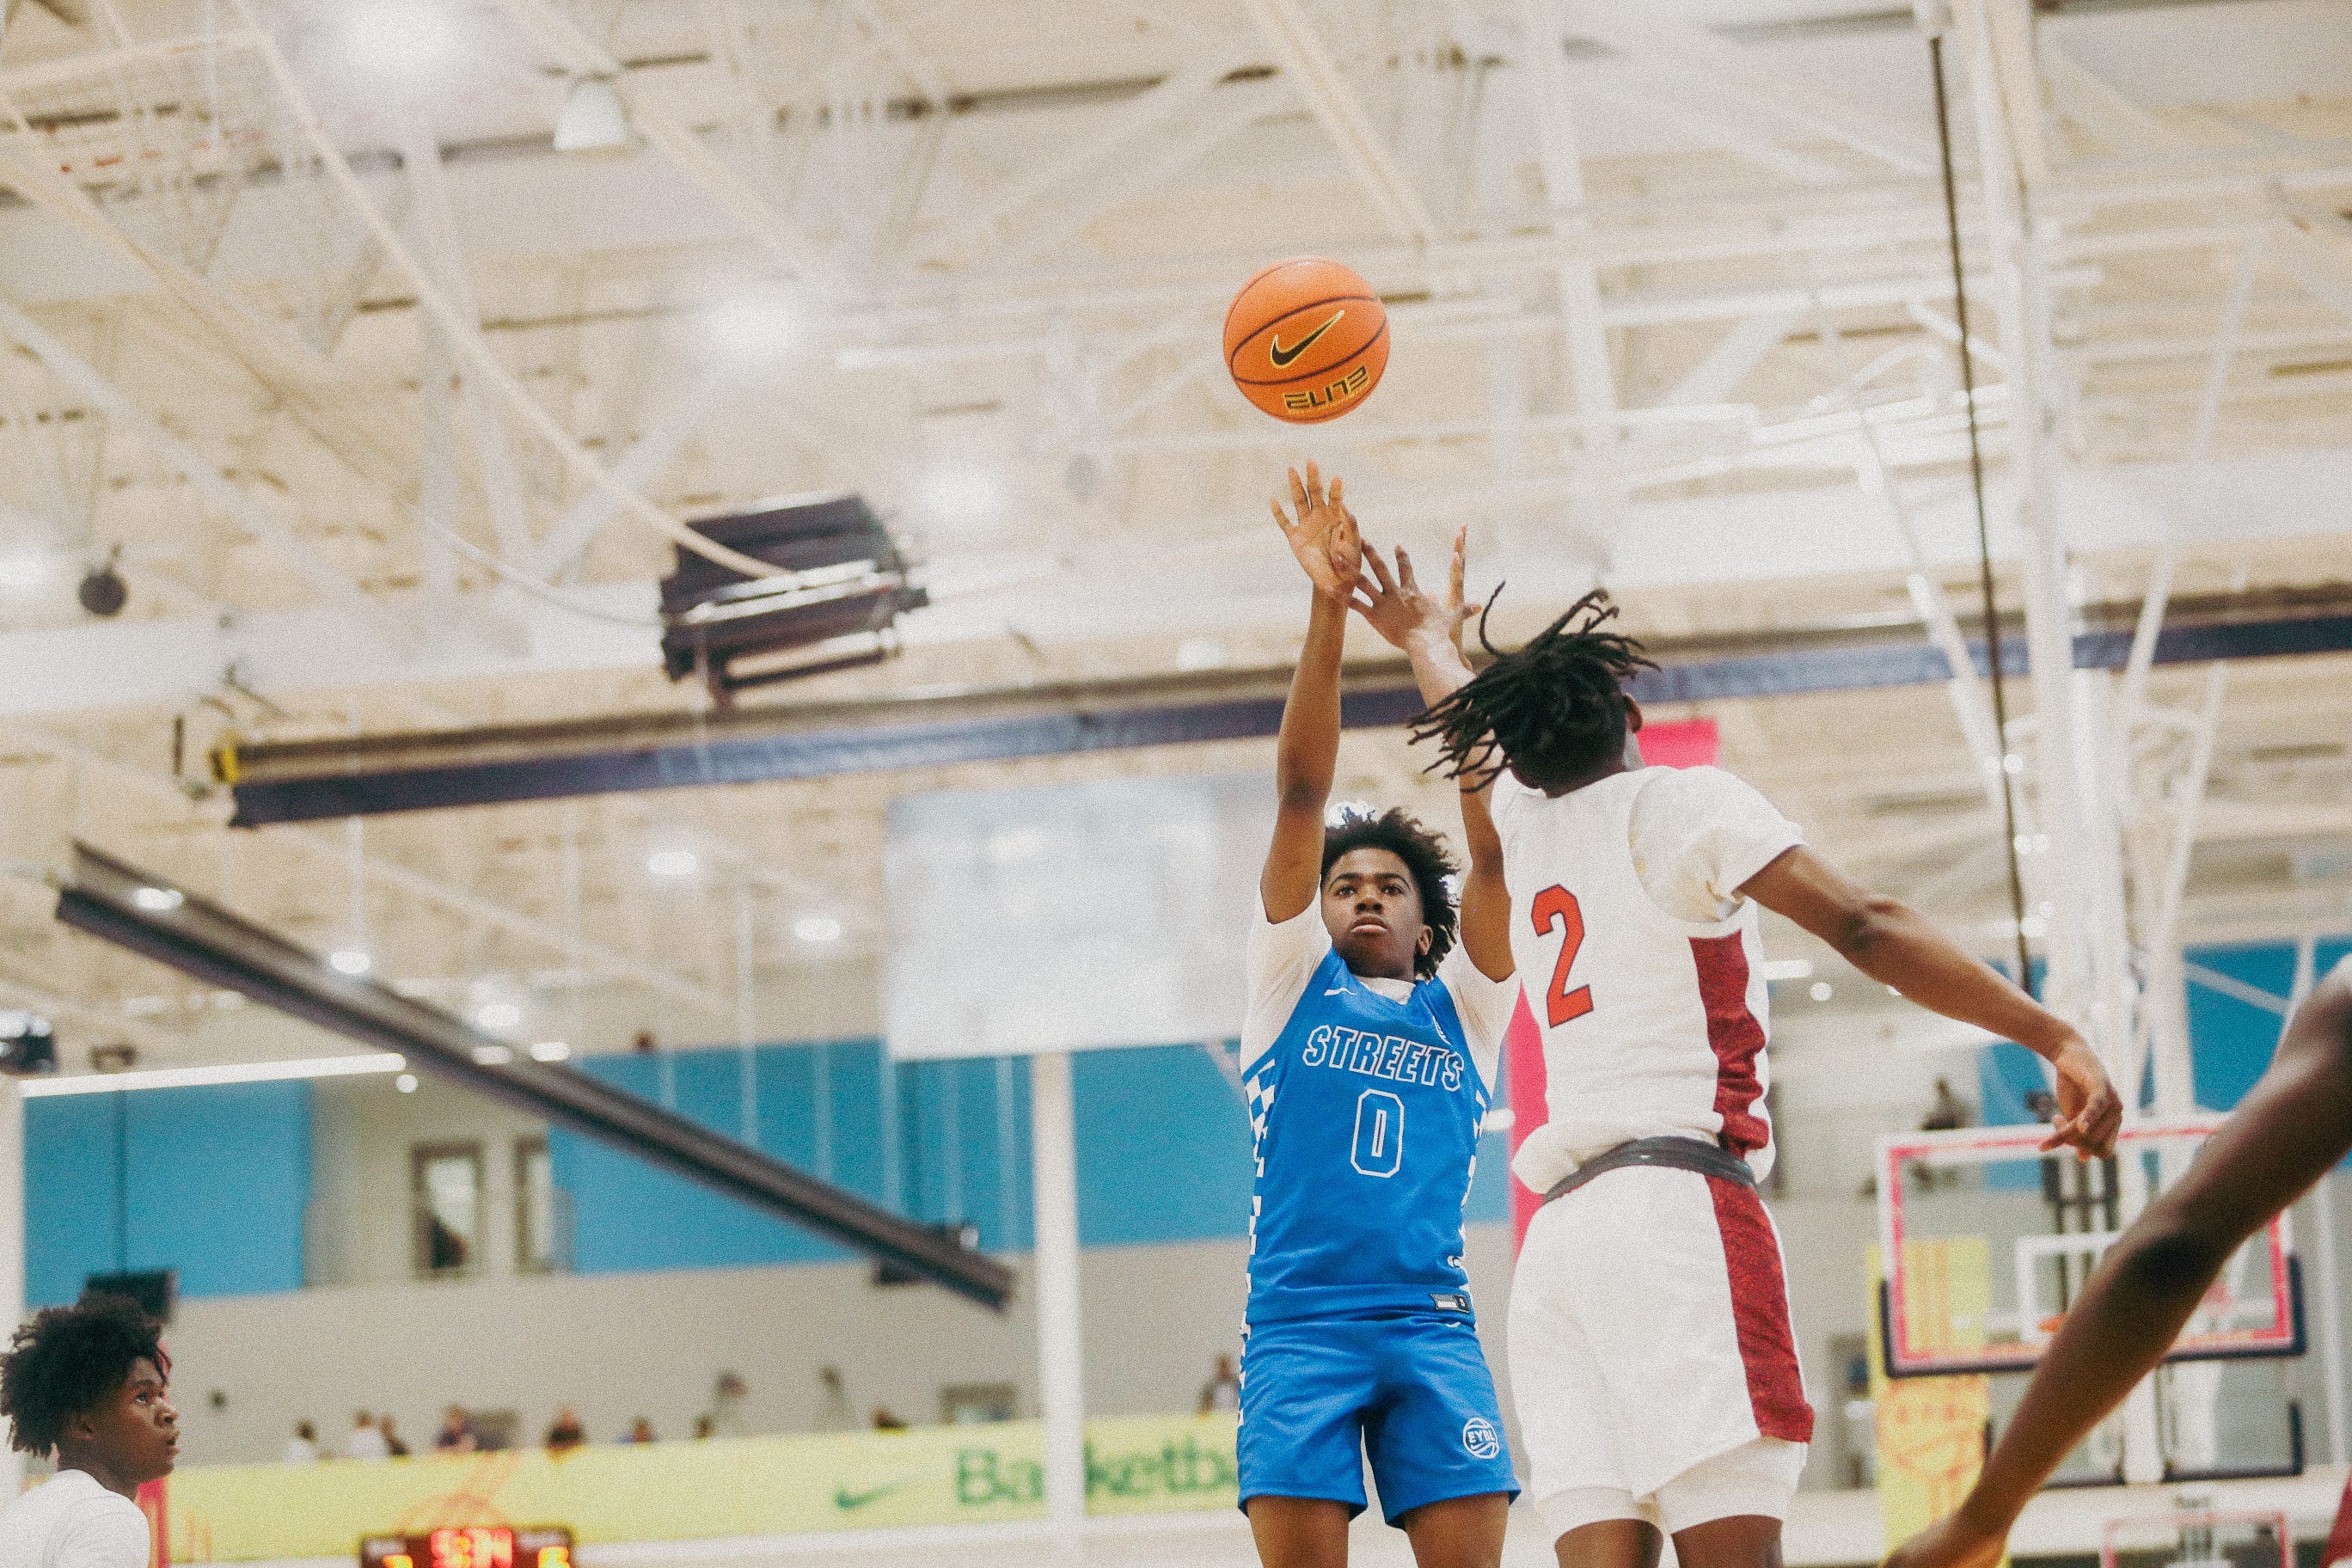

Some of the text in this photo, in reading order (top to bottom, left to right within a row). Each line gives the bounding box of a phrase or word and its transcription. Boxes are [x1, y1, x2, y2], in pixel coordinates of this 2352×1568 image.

[1283, 364, 1370, 412] ELITE
[1530, 883, 1595, 1029] 2
[1302, 1024, 1465, 1092] STREETS
[1350, 1087, 1406, 1179] 0
[954, 1432, 1239, 1506] Baketb
[1467, 1429, 1496, 1443] EYBL
